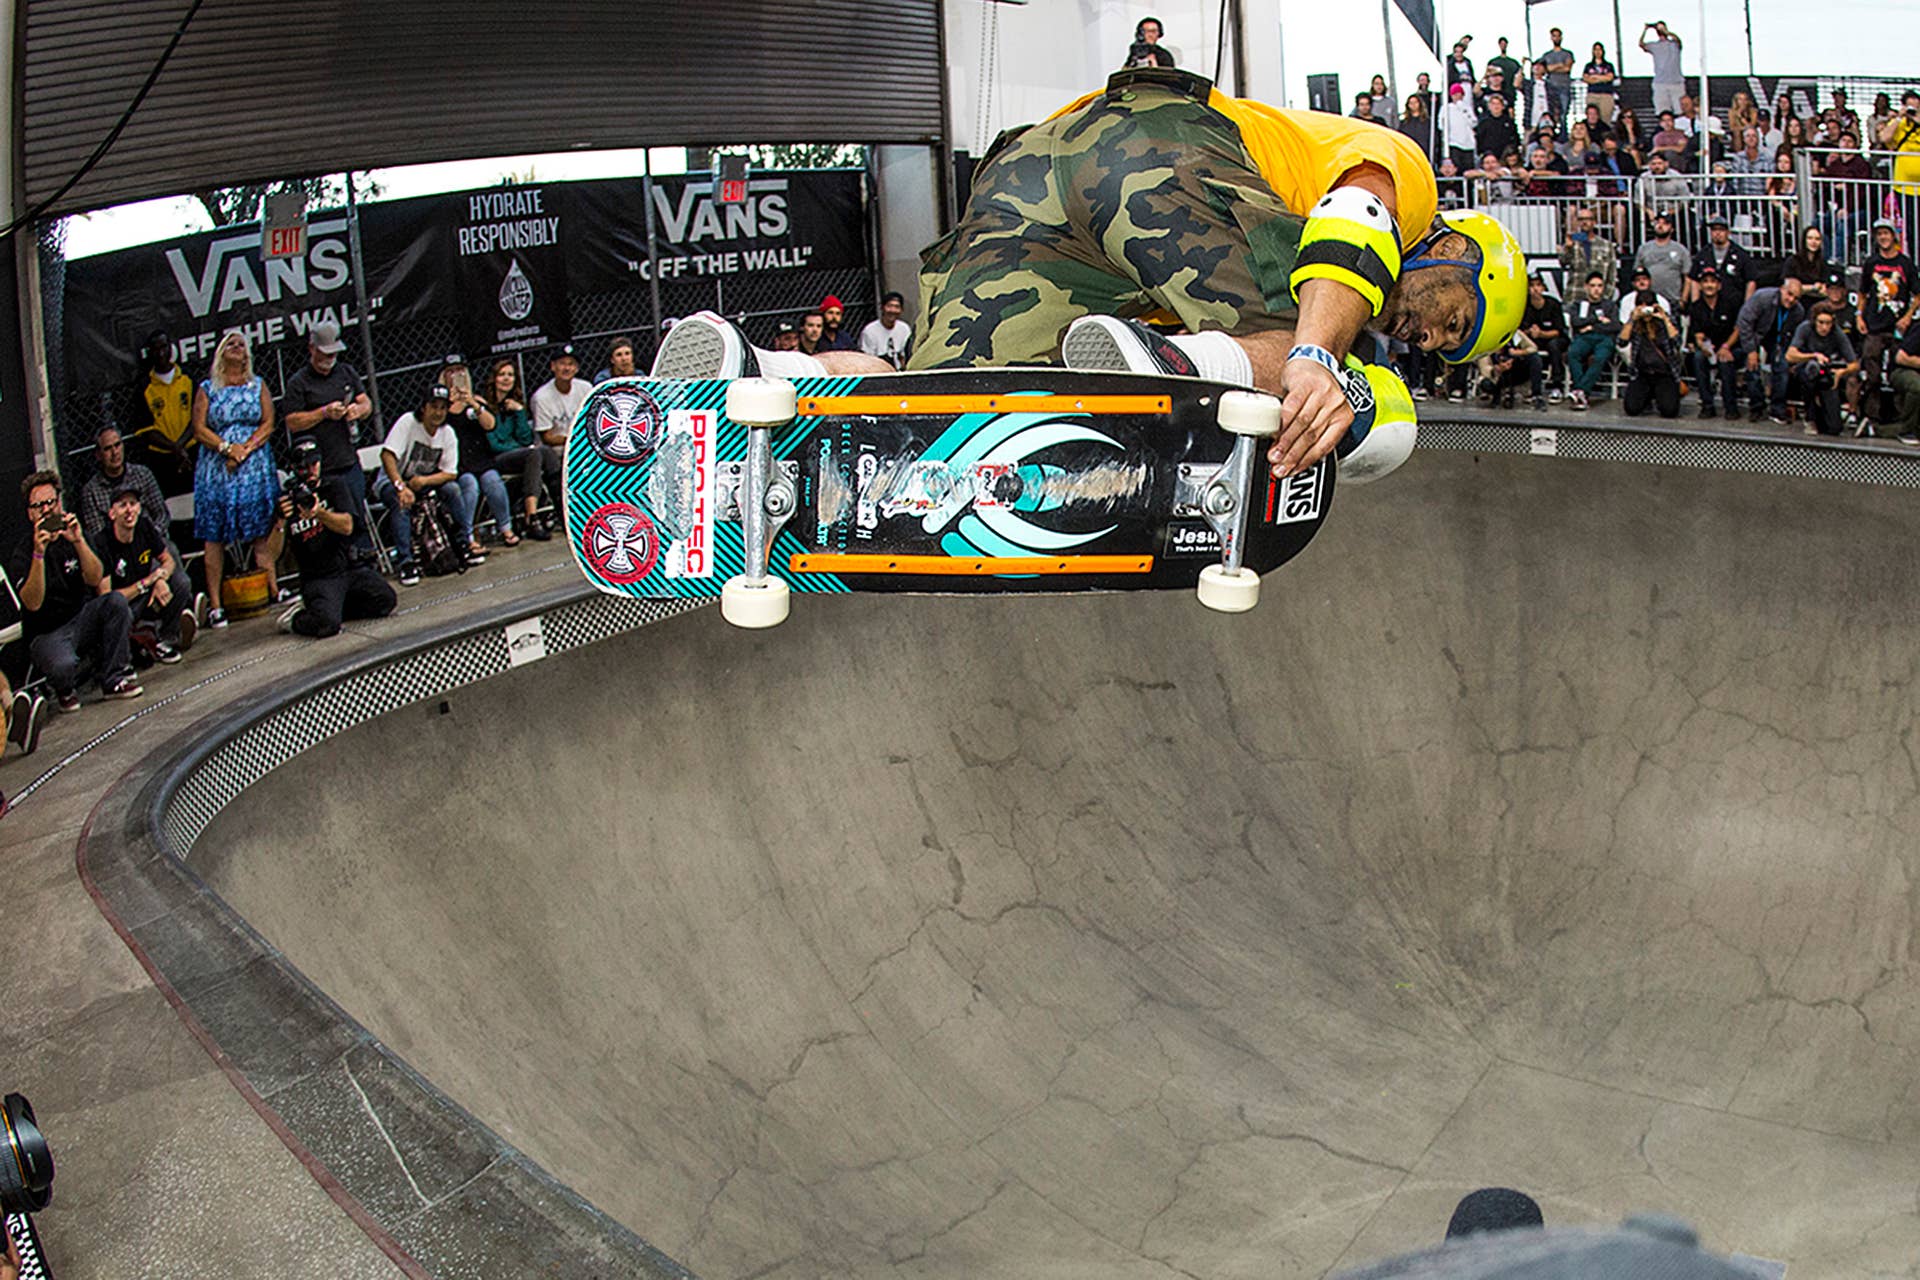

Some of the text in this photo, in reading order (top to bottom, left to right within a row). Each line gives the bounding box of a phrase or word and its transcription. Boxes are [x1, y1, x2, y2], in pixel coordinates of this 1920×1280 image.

[468, 188, 545, 222] HYDRATE
[722, 180, 747, 202] EXIT
[651, 179, 788, 243] VANS
[270, 226, 301, 256] EXIT
[458, 216, 560, 257] RESPONSIBLY
[165, 217, 348, 318] VANS
[692, 252, 740, 276] THE
[743, 246, 812, 271] WALL"
[1173, 528, 1218, 544] Jesu
